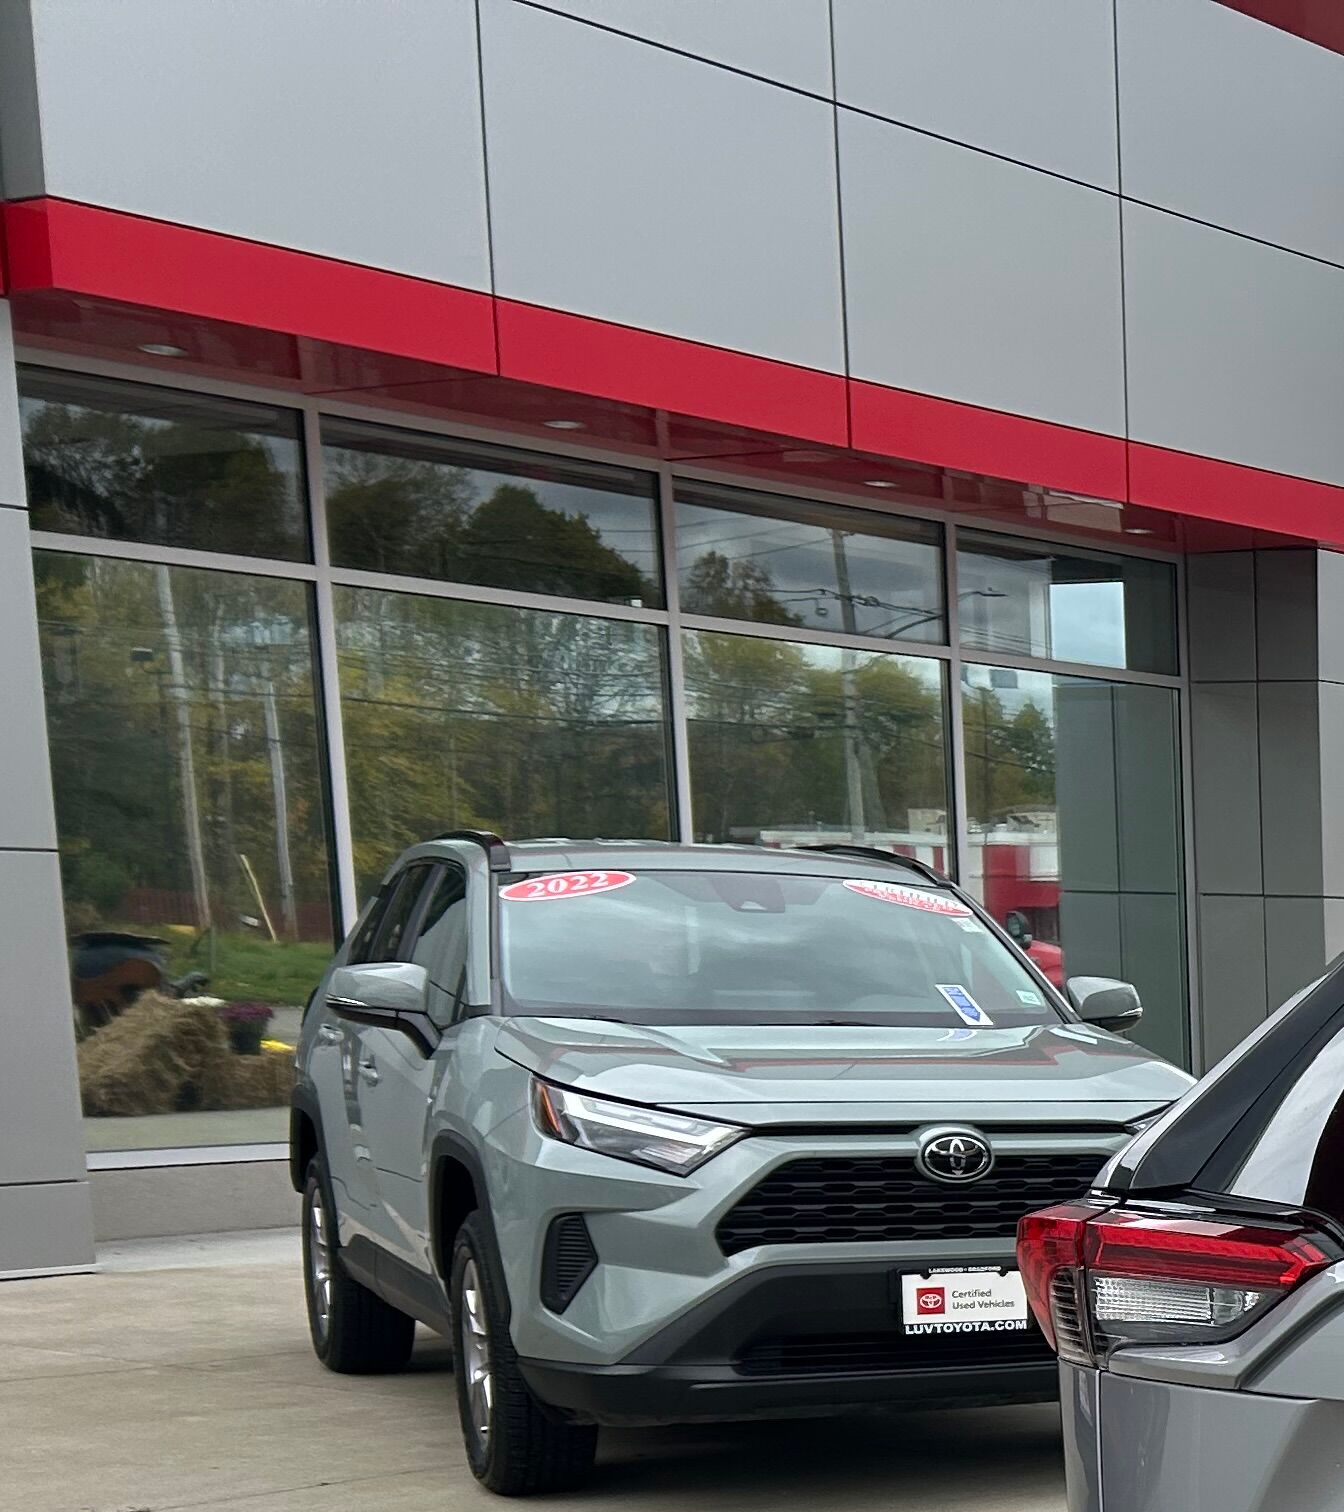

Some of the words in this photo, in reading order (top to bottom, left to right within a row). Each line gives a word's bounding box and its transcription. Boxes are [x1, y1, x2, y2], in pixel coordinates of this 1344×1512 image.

[527, 872, 609, 898] 2022
[952, 1288, 992, 1299] Certified
[952, 1300, 976, 1310] Used
[977, 1299, 1015, 1309] Vehicles
[905, 1320, 1027, 1334] LUVTOYOTA.COM
